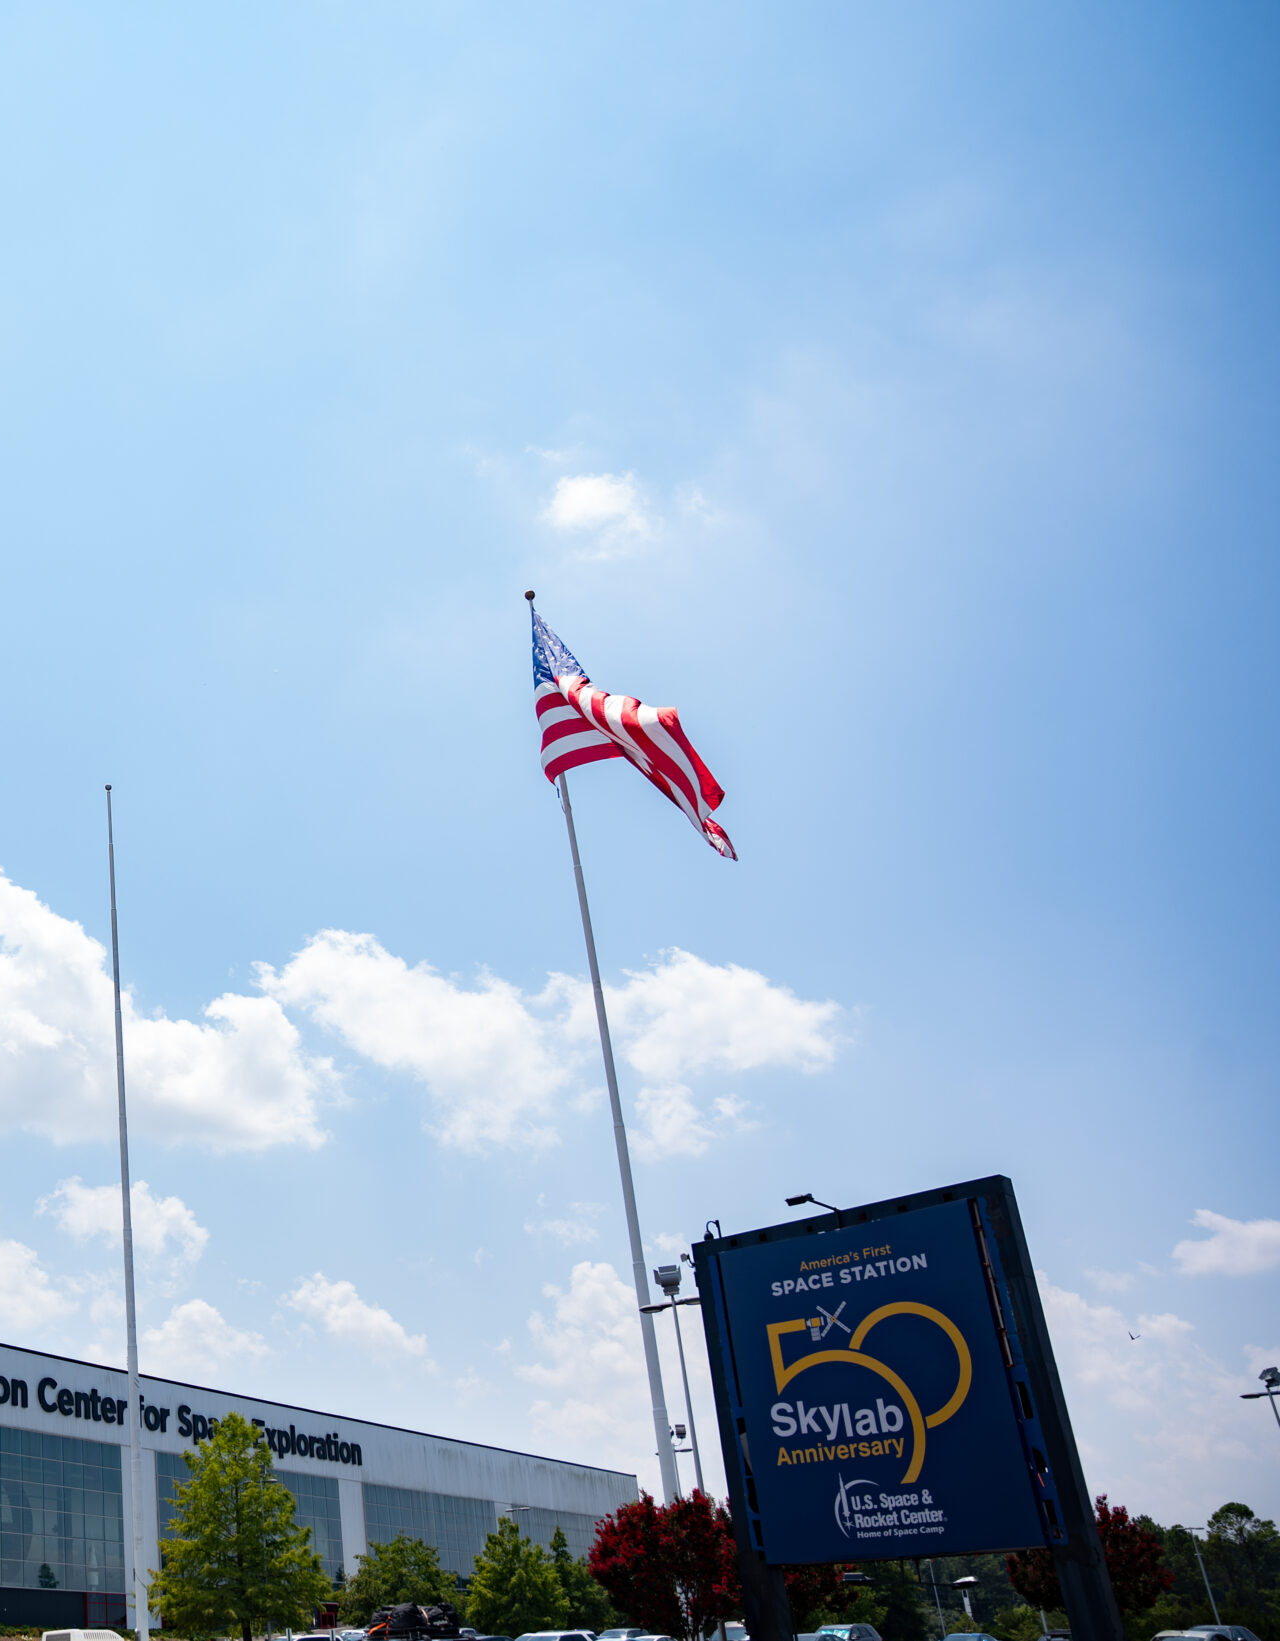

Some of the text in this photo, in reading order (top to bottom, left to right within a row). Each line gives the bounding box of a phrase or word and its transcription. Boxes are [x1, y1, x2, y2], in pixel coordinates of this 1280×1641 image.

[800, 1244, 892, 1272] America's First
[771, 1253, 928, 1297] SPACE STATION
[766, 1301, 972, 1484] 50
[37, 1377, 127, 1425] Center
[178, 1405, 226, 1446] Spa
[770, 1398, 904, 1441] Skylab
[777, 1437, 904, 1466] Anniversary
[851, 1489, 933, 1511] U.S. Space &
[854, 1511, 899, 1528] Rocket
[857, 1526, 944, 1539] Home of Space Camp
